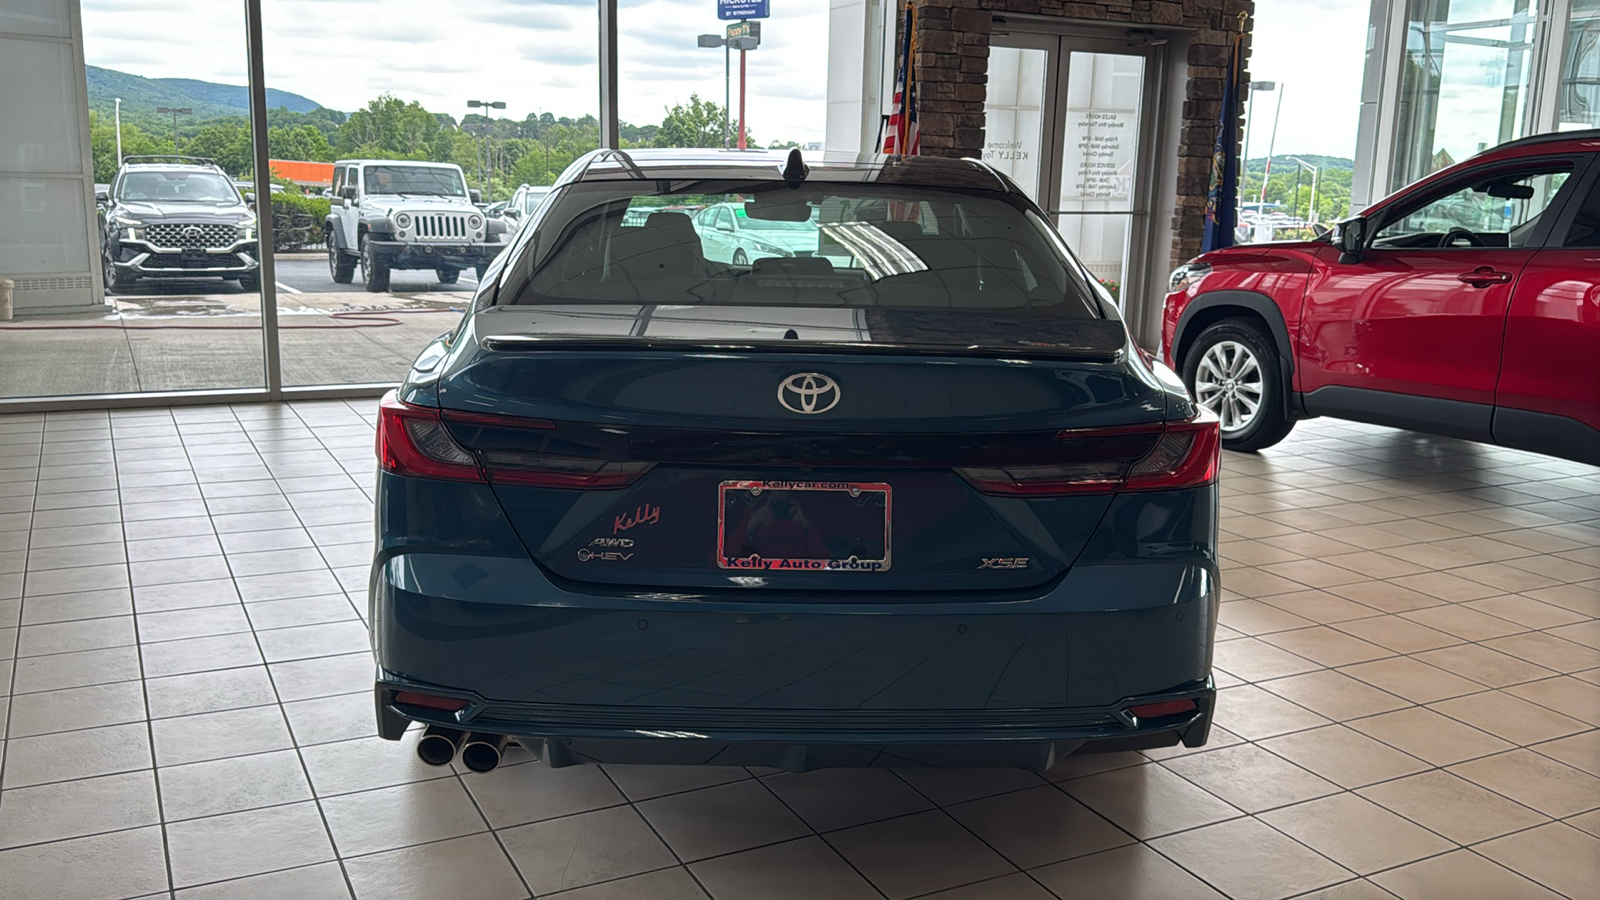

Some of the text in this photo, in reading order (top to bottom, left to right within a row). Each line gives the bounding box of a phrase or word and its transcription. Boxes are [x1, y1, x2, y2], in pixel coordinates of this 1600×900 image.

[762, 480, 850, 490] Kellycar.com
[613, 503, 660, 534] Kelly
[588, 538, 634, 548] AWD
[727, 557, 882, 572] Kelly Auto Group
[977, 558, 1029, 569] XSE
